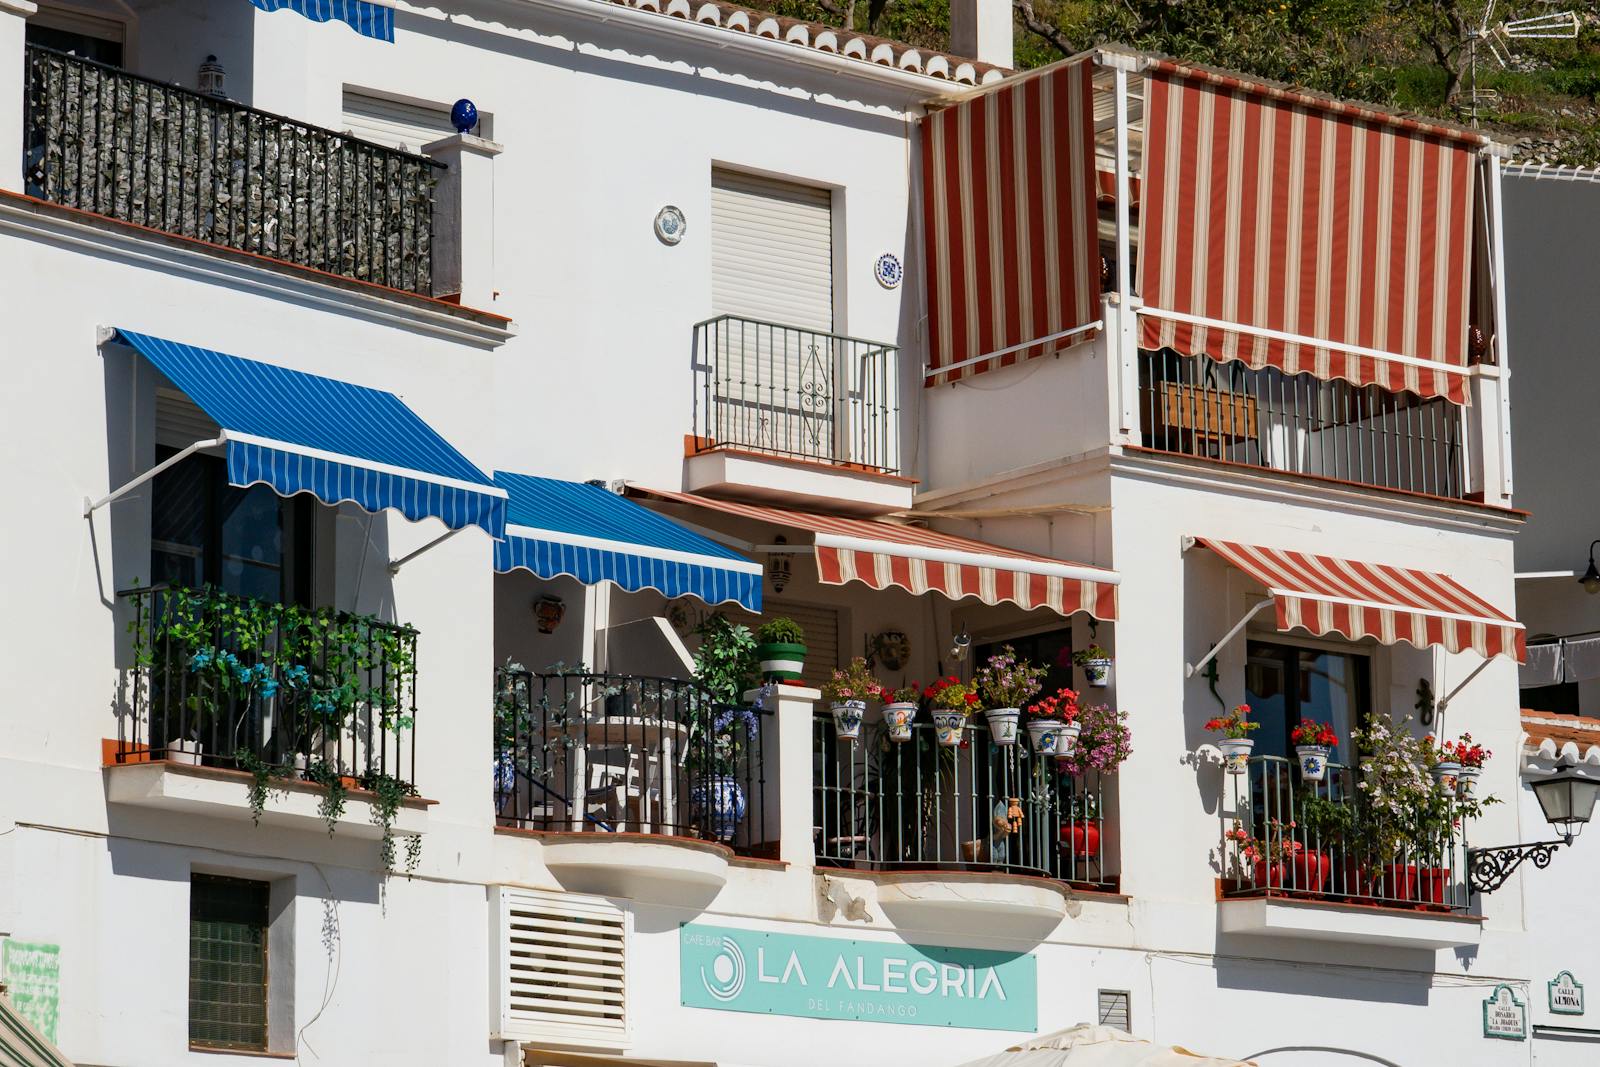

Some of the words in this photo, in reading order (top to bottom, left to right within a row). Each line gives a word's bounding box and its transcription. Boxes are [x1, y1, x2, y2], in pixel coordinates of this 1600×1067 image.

[705, 935, 722, 947] BAR
[757, 947, 808, 986] LA
[826, 953, 1007, 1000] ALEGRIA
[1557, 988, 1574, 996] CALLE
[808, 998, 831, 1011] DEL
[838, 1000, 918, 1017] FANDANGO
[1553, 996, 1580, 1007] ALMONA
